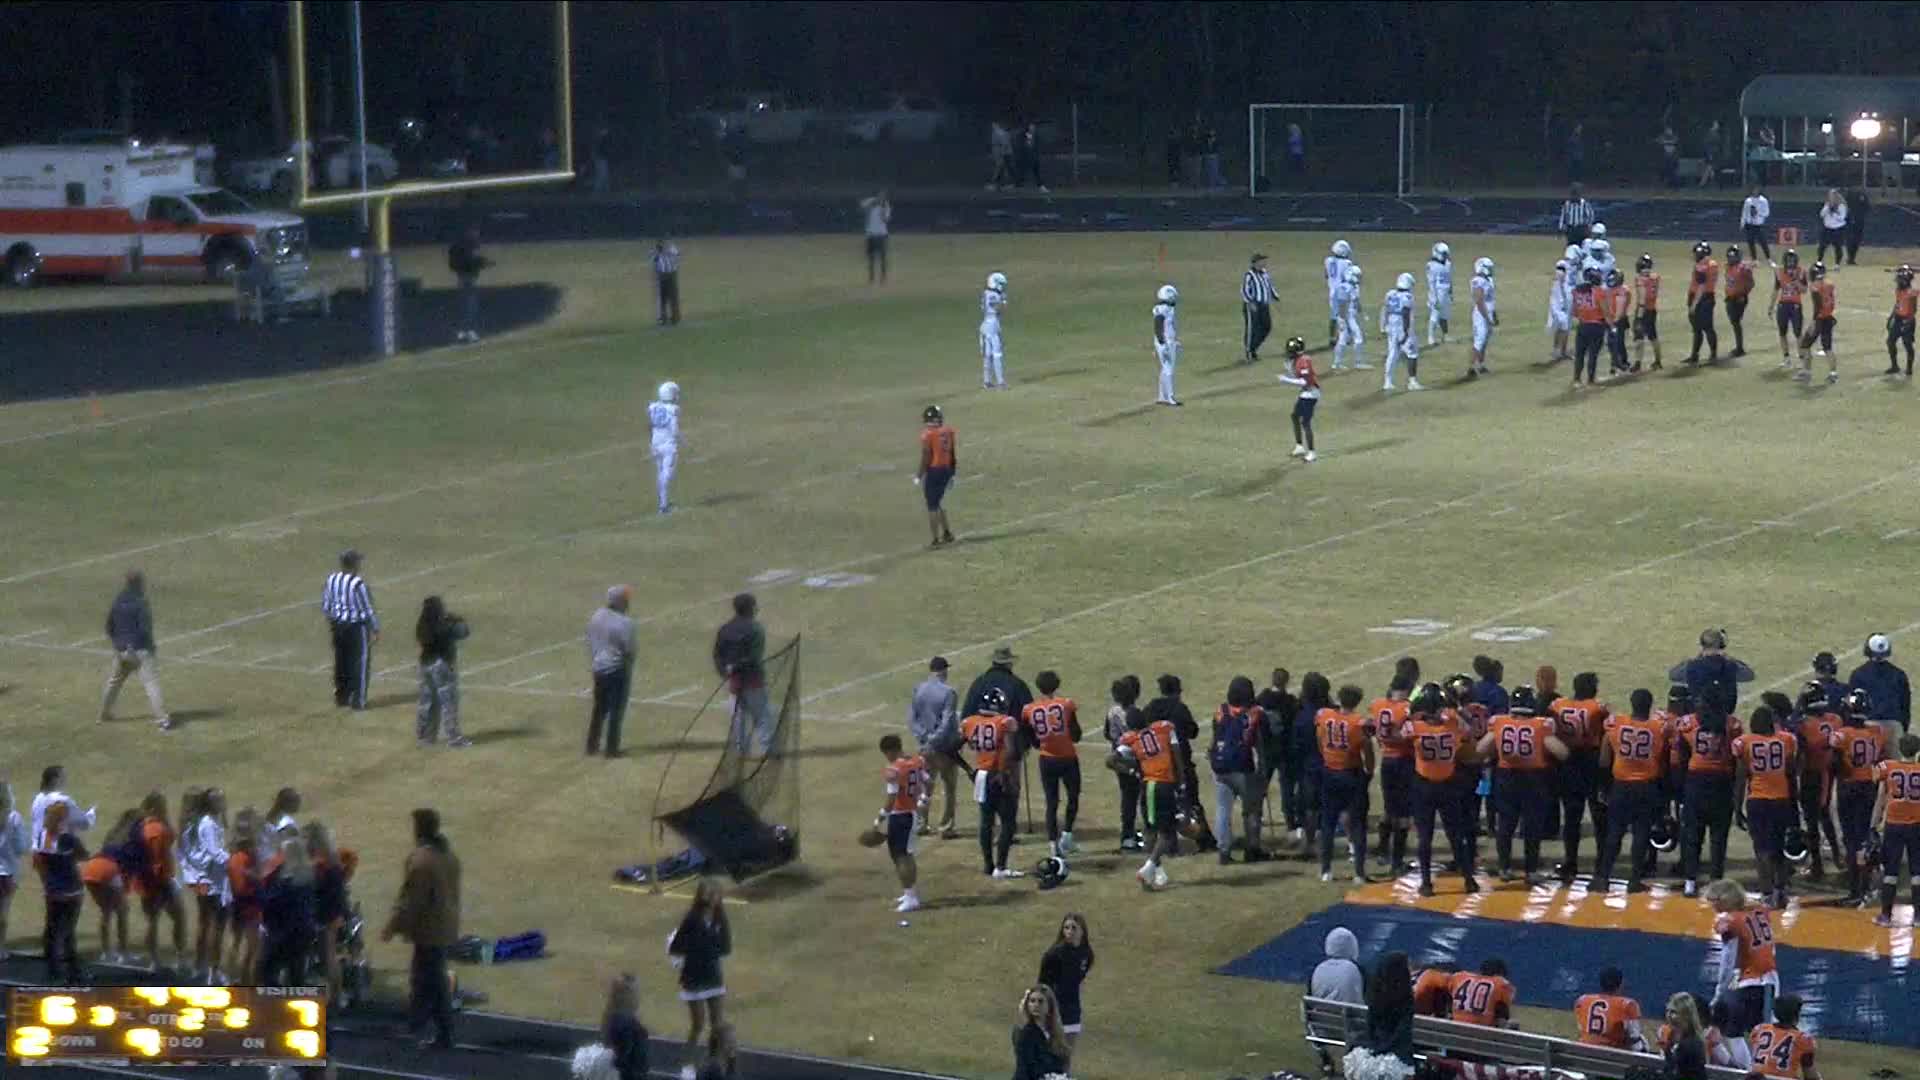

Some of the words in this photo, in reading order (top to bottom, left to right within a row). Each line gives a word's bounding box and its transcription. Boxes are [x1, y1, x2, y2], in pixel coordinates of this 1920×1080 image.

[1032, 703, 1066, 736] 83
[1326, 719, 1349, 750] 11
[969, 722, 997, 752] 48
[1140, 729, 1161, 757] 0
[1420, 733, 1454, 761] 55
[1501, 725, 1534, 757] 66
[1619, 726, 1652, 760] 52
[1751, 740, 1785, 772] 58
[1891, 770, 1920, 800] 39
[1745, 910, 1773, 947] 16
[1453, 977, 1493, 1015] 40
[1588, 1000, 1609, 1035] 6
[1753, 1030, 1795, 1069] 24
